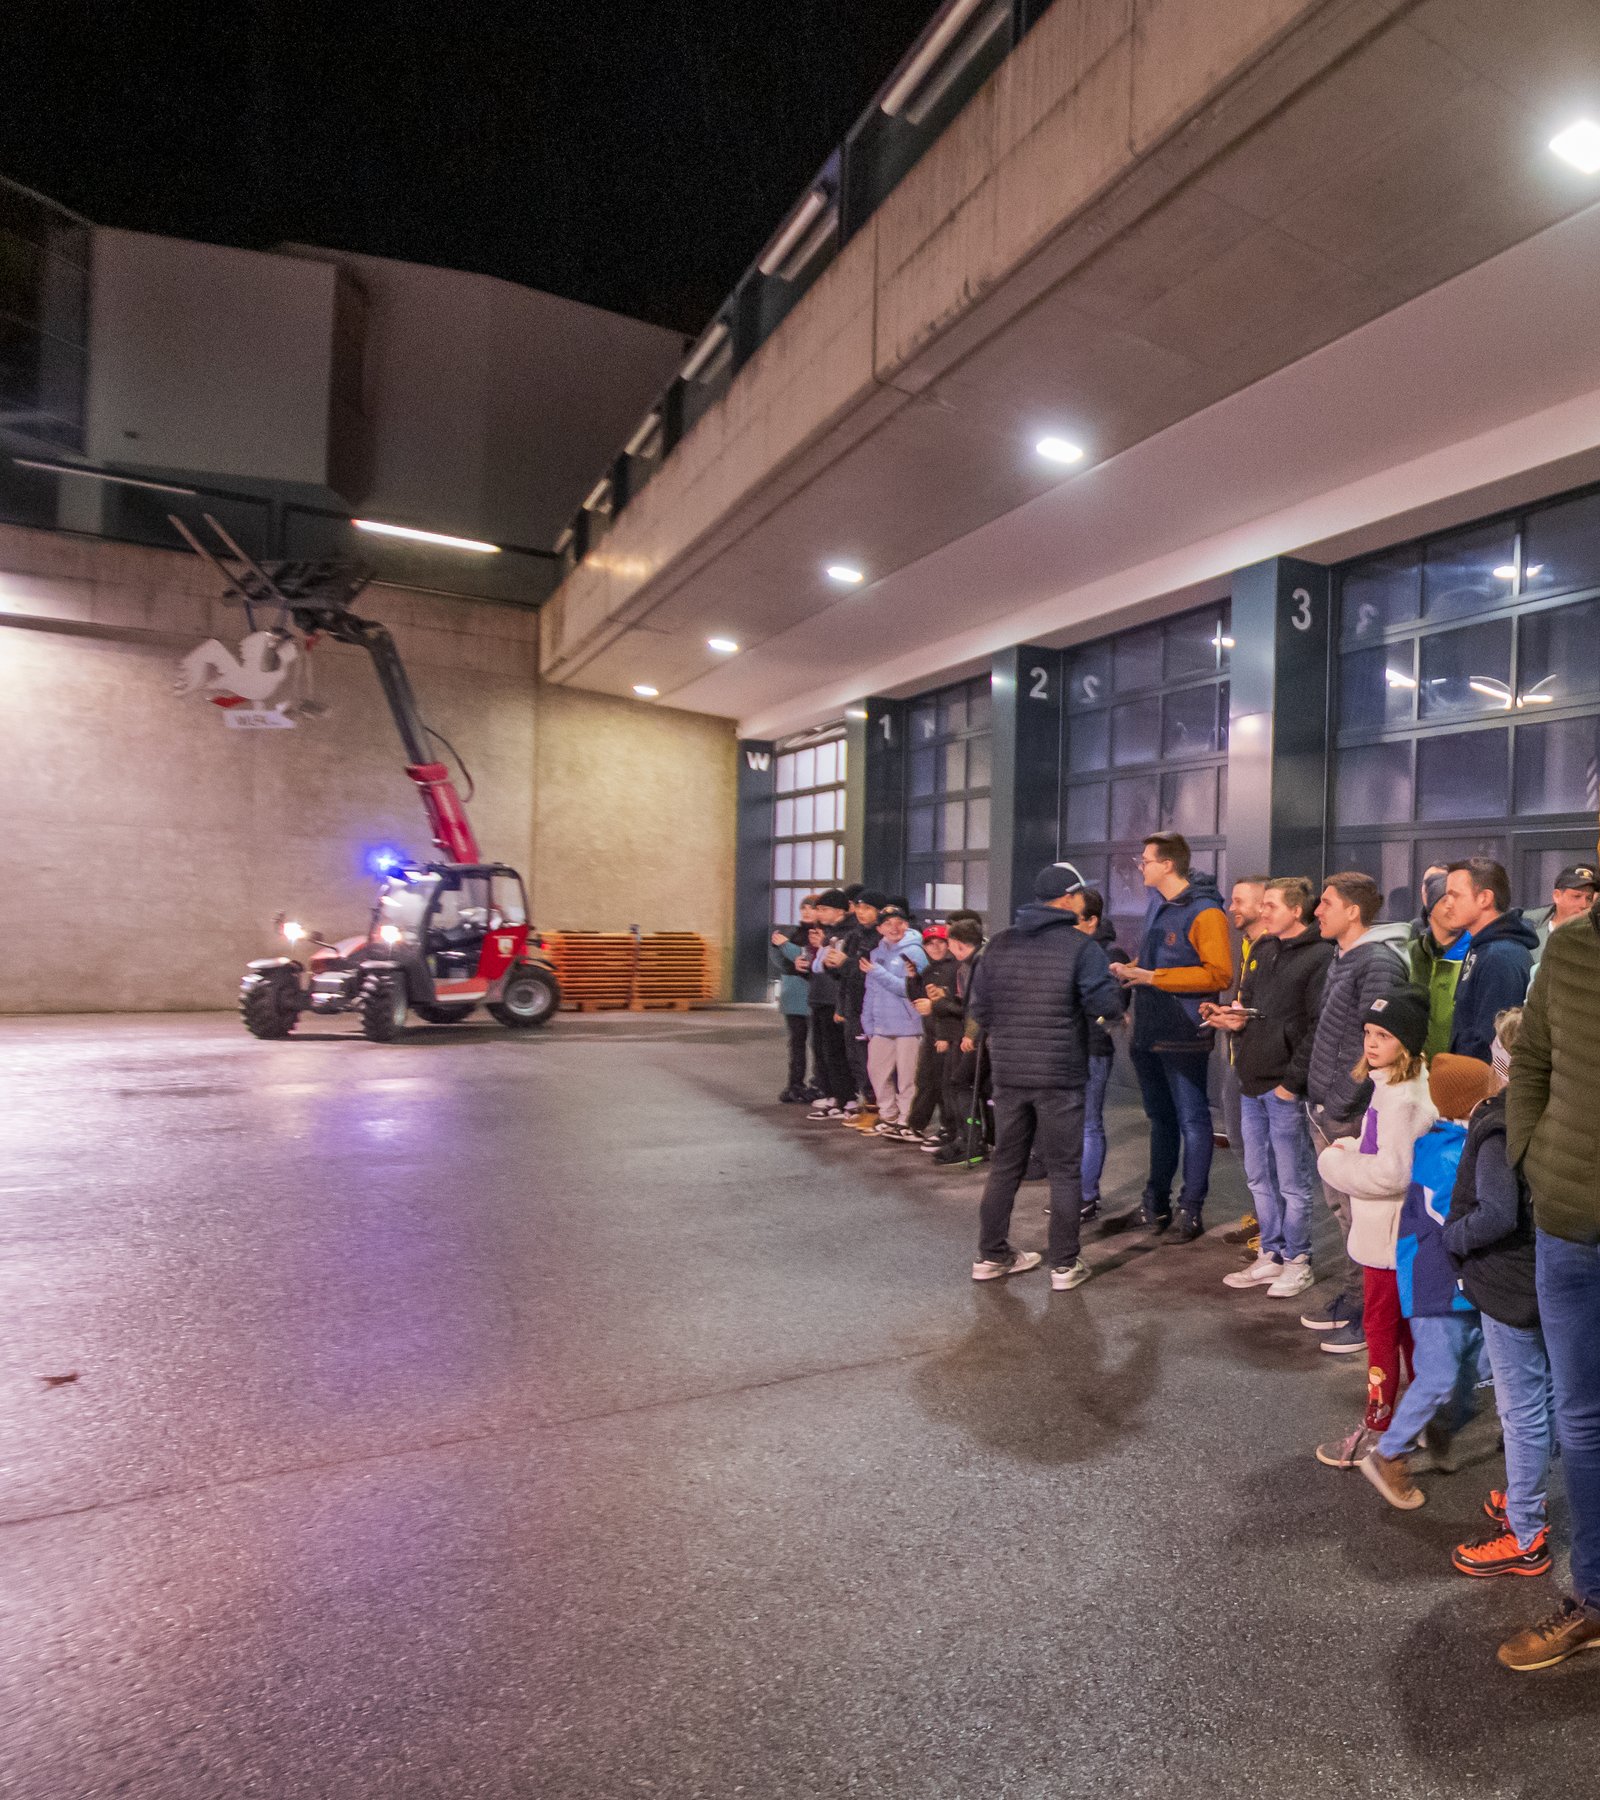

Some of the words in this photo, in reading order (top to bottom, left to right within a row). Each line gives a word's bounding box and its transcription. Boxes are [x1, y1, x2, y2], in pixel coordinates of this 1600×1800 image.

[1291, 587, 1311, 631] 3
[1029, 666, 1048, 700] 2
[879, 713, 891, 740] 1
[745, 751, 771, 771] W
